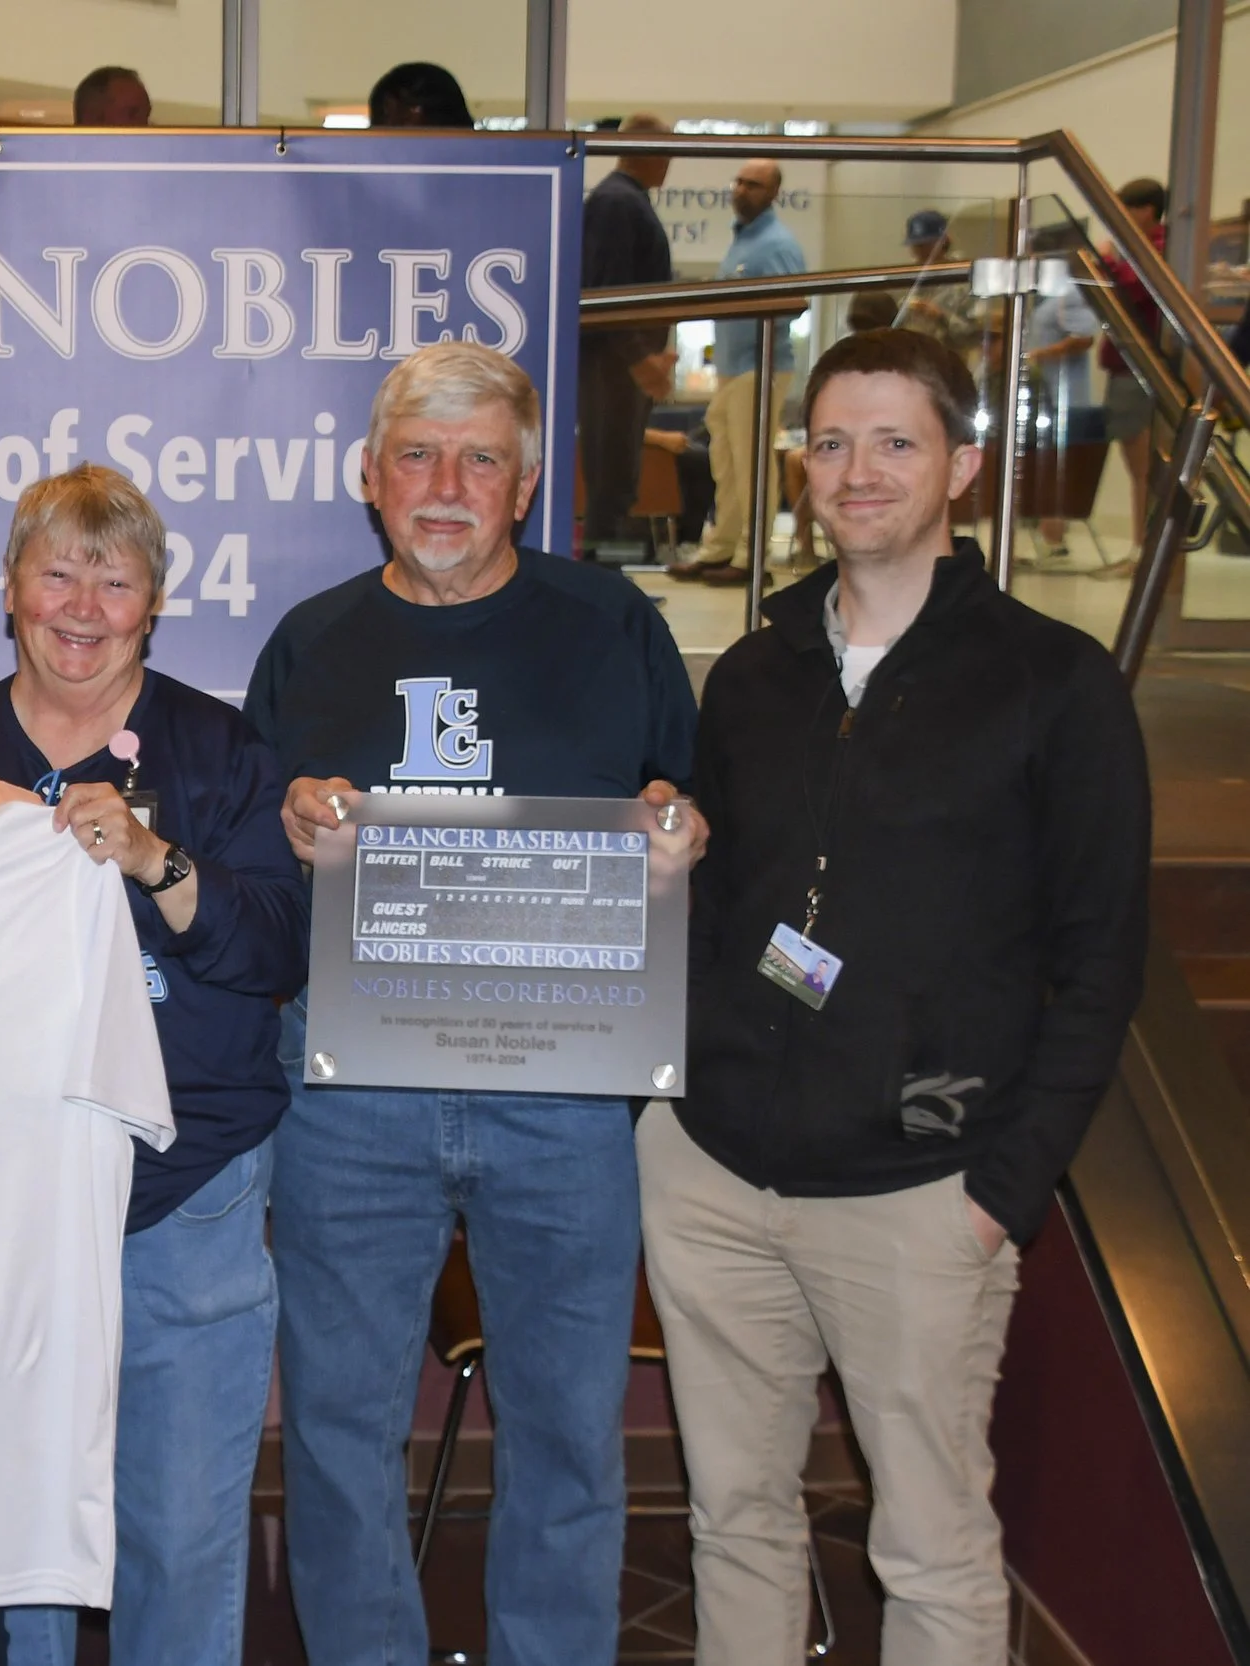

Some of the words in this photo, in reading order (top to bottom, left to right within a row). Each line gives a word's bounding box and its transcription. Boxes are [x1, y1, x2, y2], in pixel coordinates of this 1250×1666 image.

[106, 413, 368, 503] Servic
[388, 826, 489, 848] LANCER
[496, 829, 614, 851] BASEBALL
[365, 853, 419, 866] BATTER
[430, 855, 465, 867] BALL
[481, 857, 532, 869] STRIKE
[552, 858, 583, 870] OUT
[372, 902, 428, 916] GUEST
[360, 920, 427, 936] LANCERS
[358, 941, 451, 964] NOBLES
[460, 945, 640, 970] SCOREBOARD
[353, 976, 453, 1001] NOBLES
[461, 980, 646, 1008] SCOREBOARD
[380, 1014, 393, 1025] In
[395, 1016, 465, 1029] recognition
[466, 1018, 480, 1029] of
[536, 1019, 549, 1031] of
[598, 1020, 613, 1034] by
[435, 1032, 490, 1049] Susan
[495, 1034, 557, 1051] Nobles
[466, 1054, 527, 1066] 1974-2024
